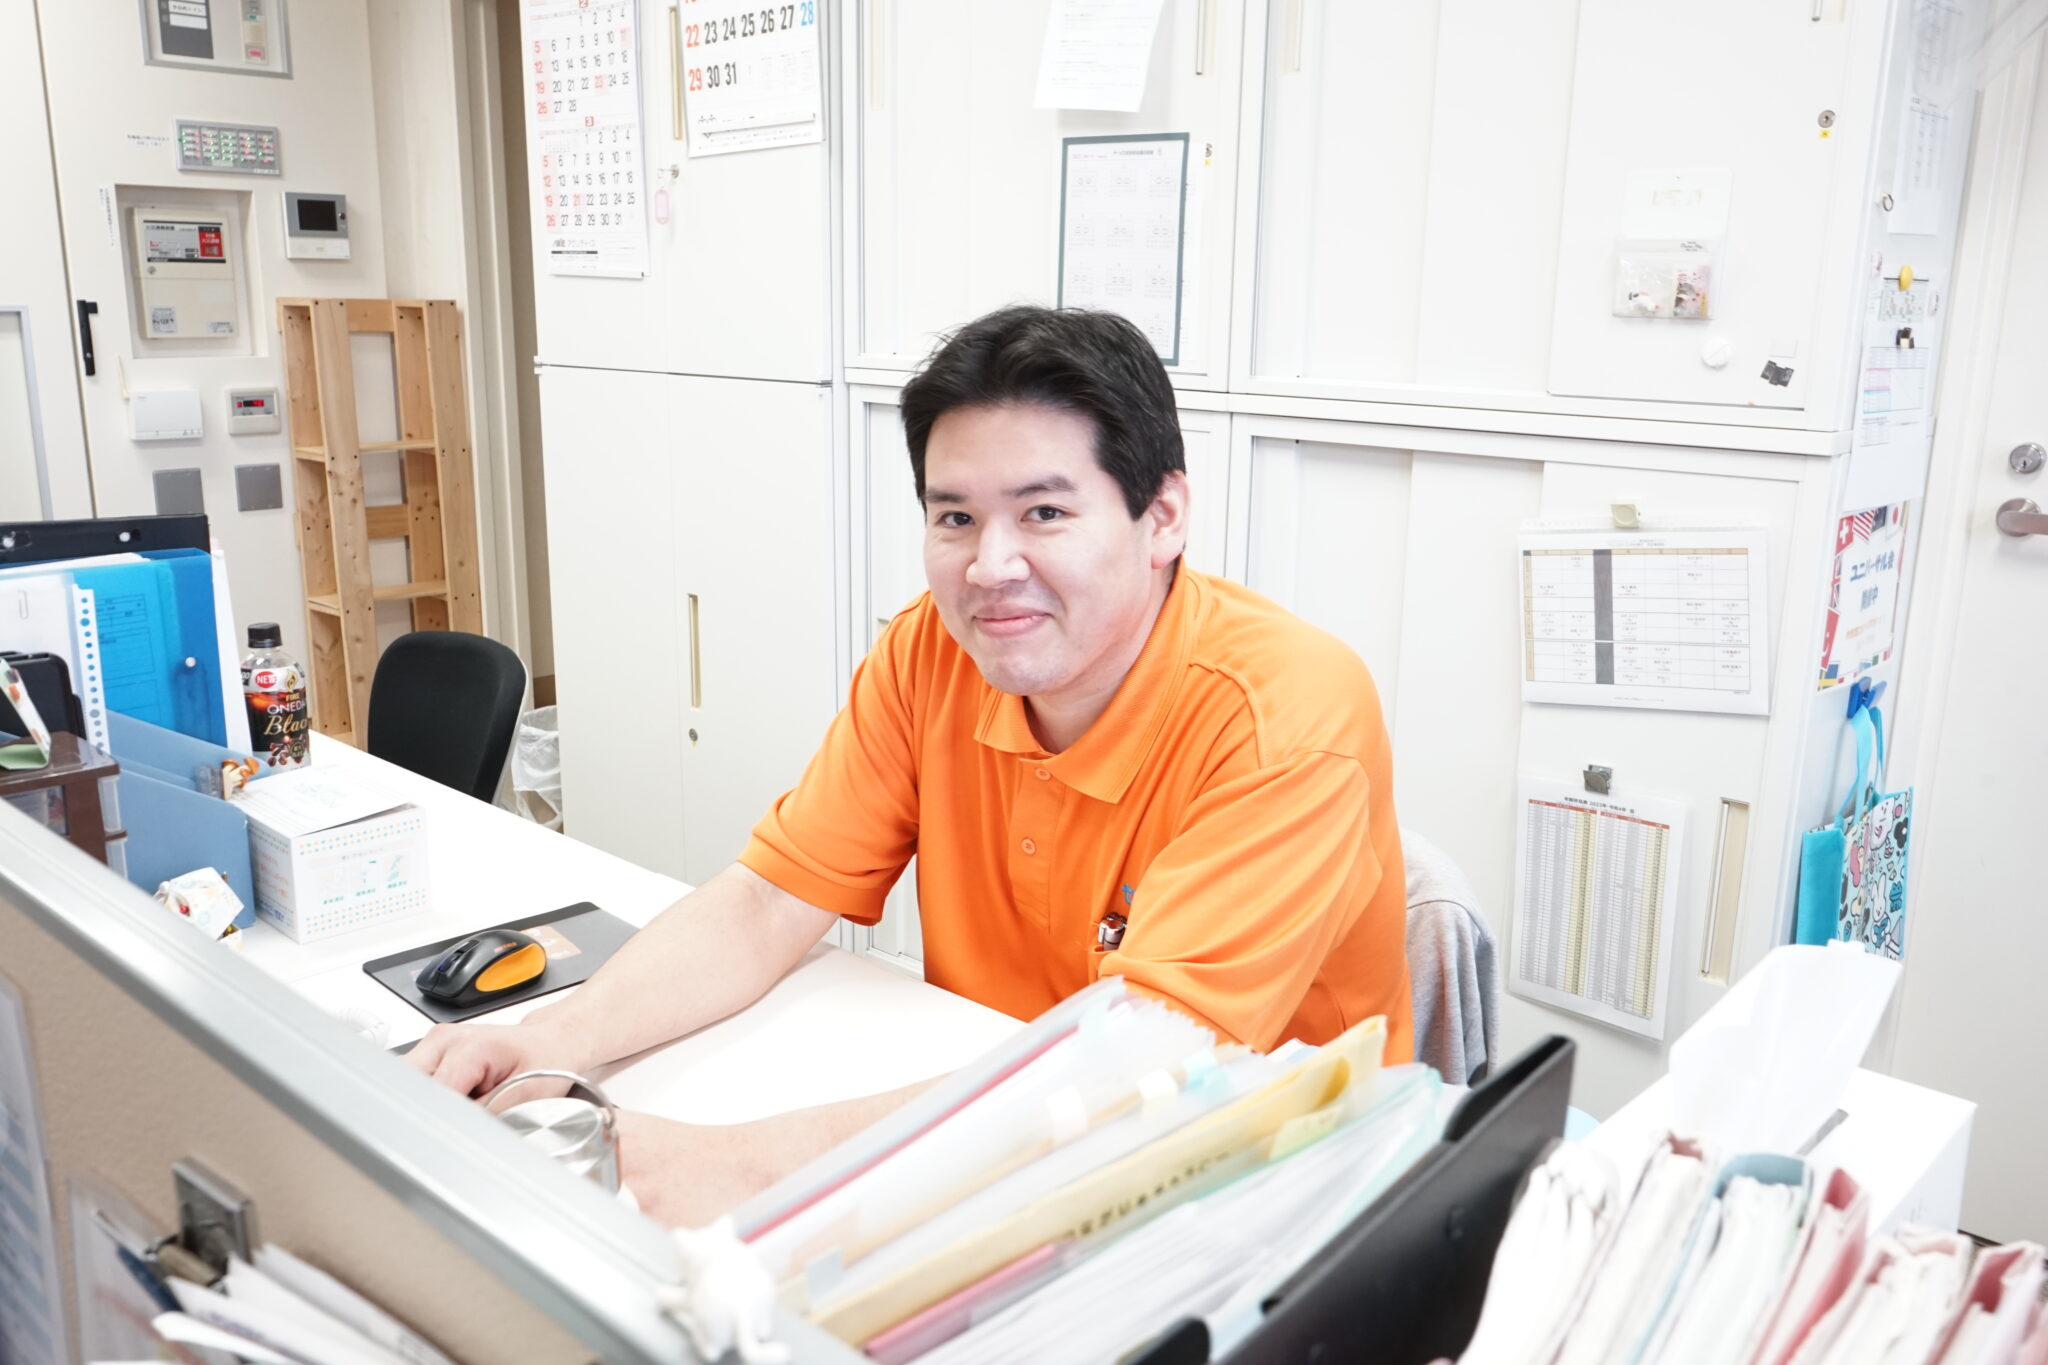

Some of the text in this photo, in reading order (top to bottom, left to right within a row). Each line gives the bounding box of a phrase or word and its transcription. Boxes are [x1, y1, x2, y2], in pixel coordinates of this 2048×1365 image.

[686, 0, 814, 48] 22 23 24 25 26 27 28
[534, 41, 541, 53] 5
[552, 40, 557, 52] 6
[566, 37, 570, 49] 7
[580, 35, 585, 48] 8
[594, 33, 598, 46] 9
[607, 31, 614, 43] 10
[534, 50, 628, 73] 12 13 14 15 16 17 18
[536, 71, 629, 94] 19 20 21 22 23 24 25
[688, 62, 737, 91] 29 30 31
[537, 99, 577, 114] 26 27 28
[543, 151, 631, 167] 5 6 7 8 9 10 11
[544, 171, 633, 187] 12 13 14 15 16 17 18
[545, 191, 636, 207] 19 20 21 22 23 24 25
[546, 212, 622, 227] 26 27 28 29 30 31
[256, 675, 277, 684] NEW
